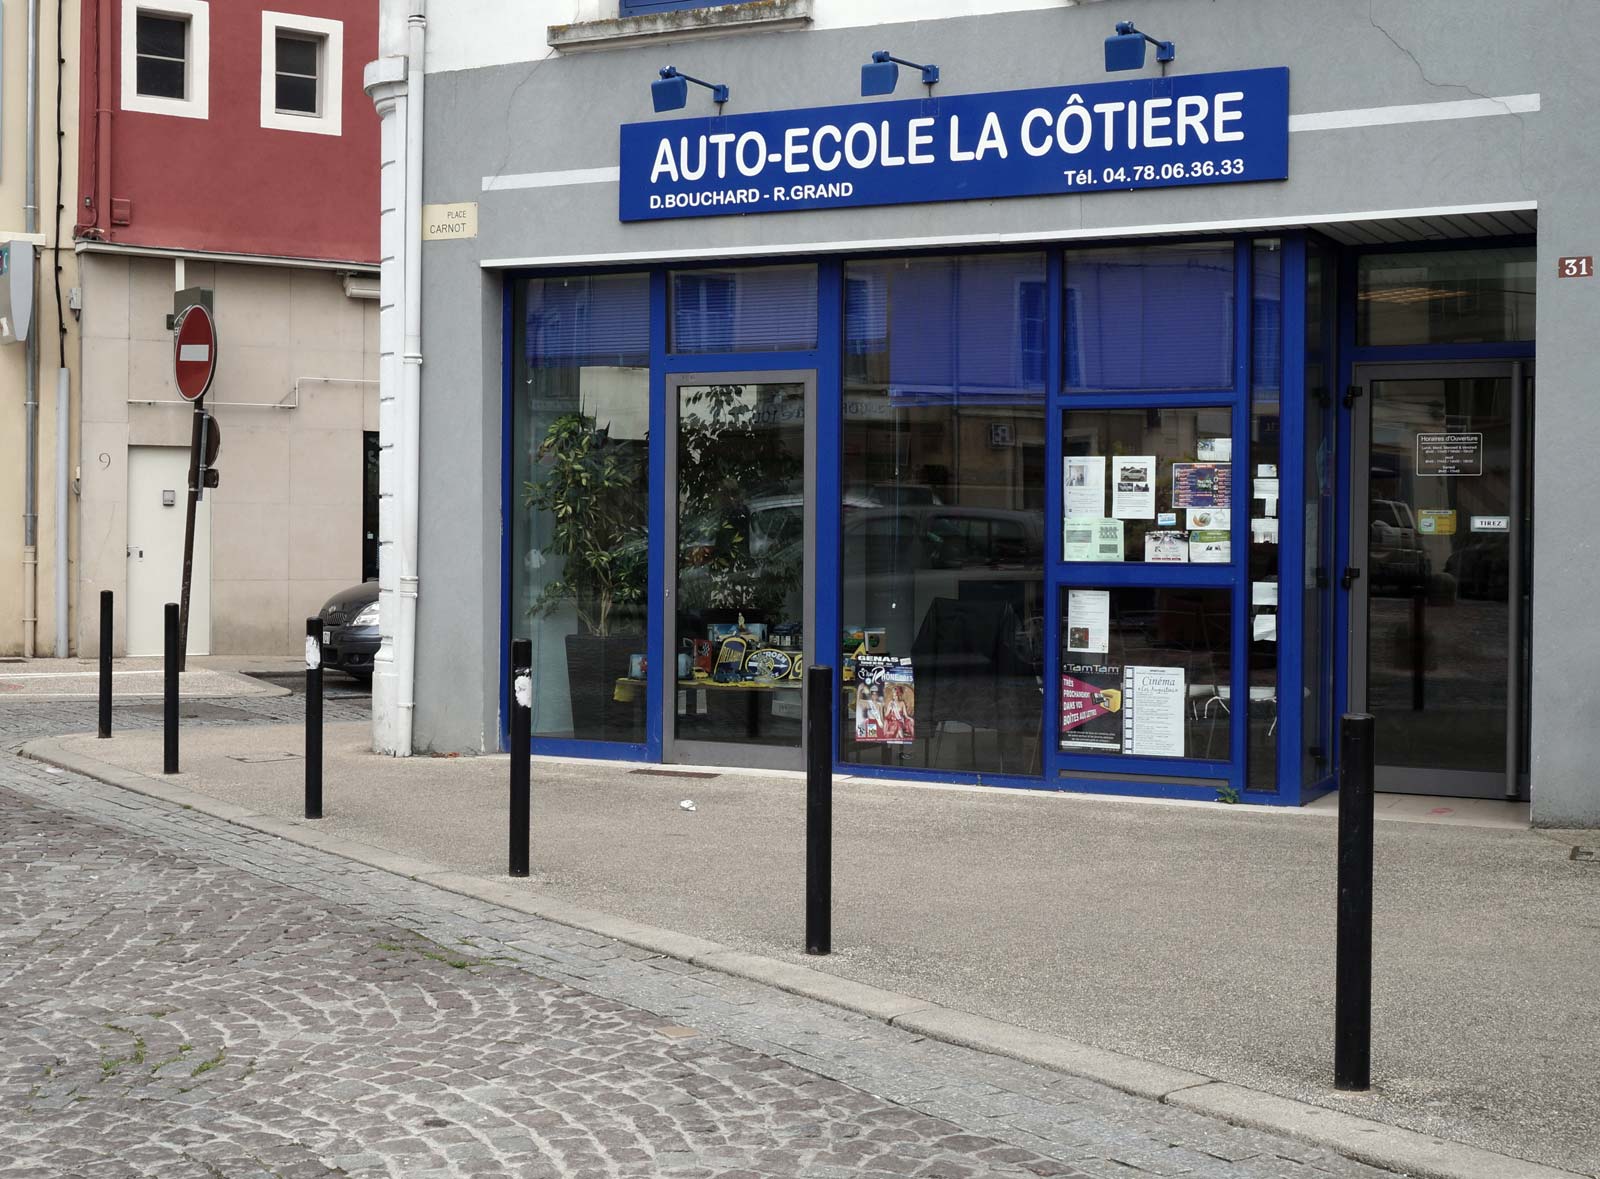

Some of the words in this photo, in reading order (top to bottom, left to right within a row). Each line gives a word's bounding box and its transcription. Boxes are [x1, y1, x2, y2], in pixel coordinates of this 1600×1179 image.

[650, 115, 937, 183] AUTO-ECOLE
[949, 111, 1009, 162] LA
[1020, 92, 1246, 157] CÔTIERE
[1063, 169, 1098, 186] Tél.
[1102, 158, 1245, 184] 04.78.06.36.33
[649, 188, 760, 210] D.BOUCHARD
[773, 182, 854, 202] R.GRAND
[447, 210, 467, 219] PLACE
[429, 222, 467, 234] CARNOT
[1565, 258, 1588, 276] 31
[98, 452, 111, 471] 9
[858, 655, 899, 663] GENAS
[1142, 675, 1176, 686] Cinéma
